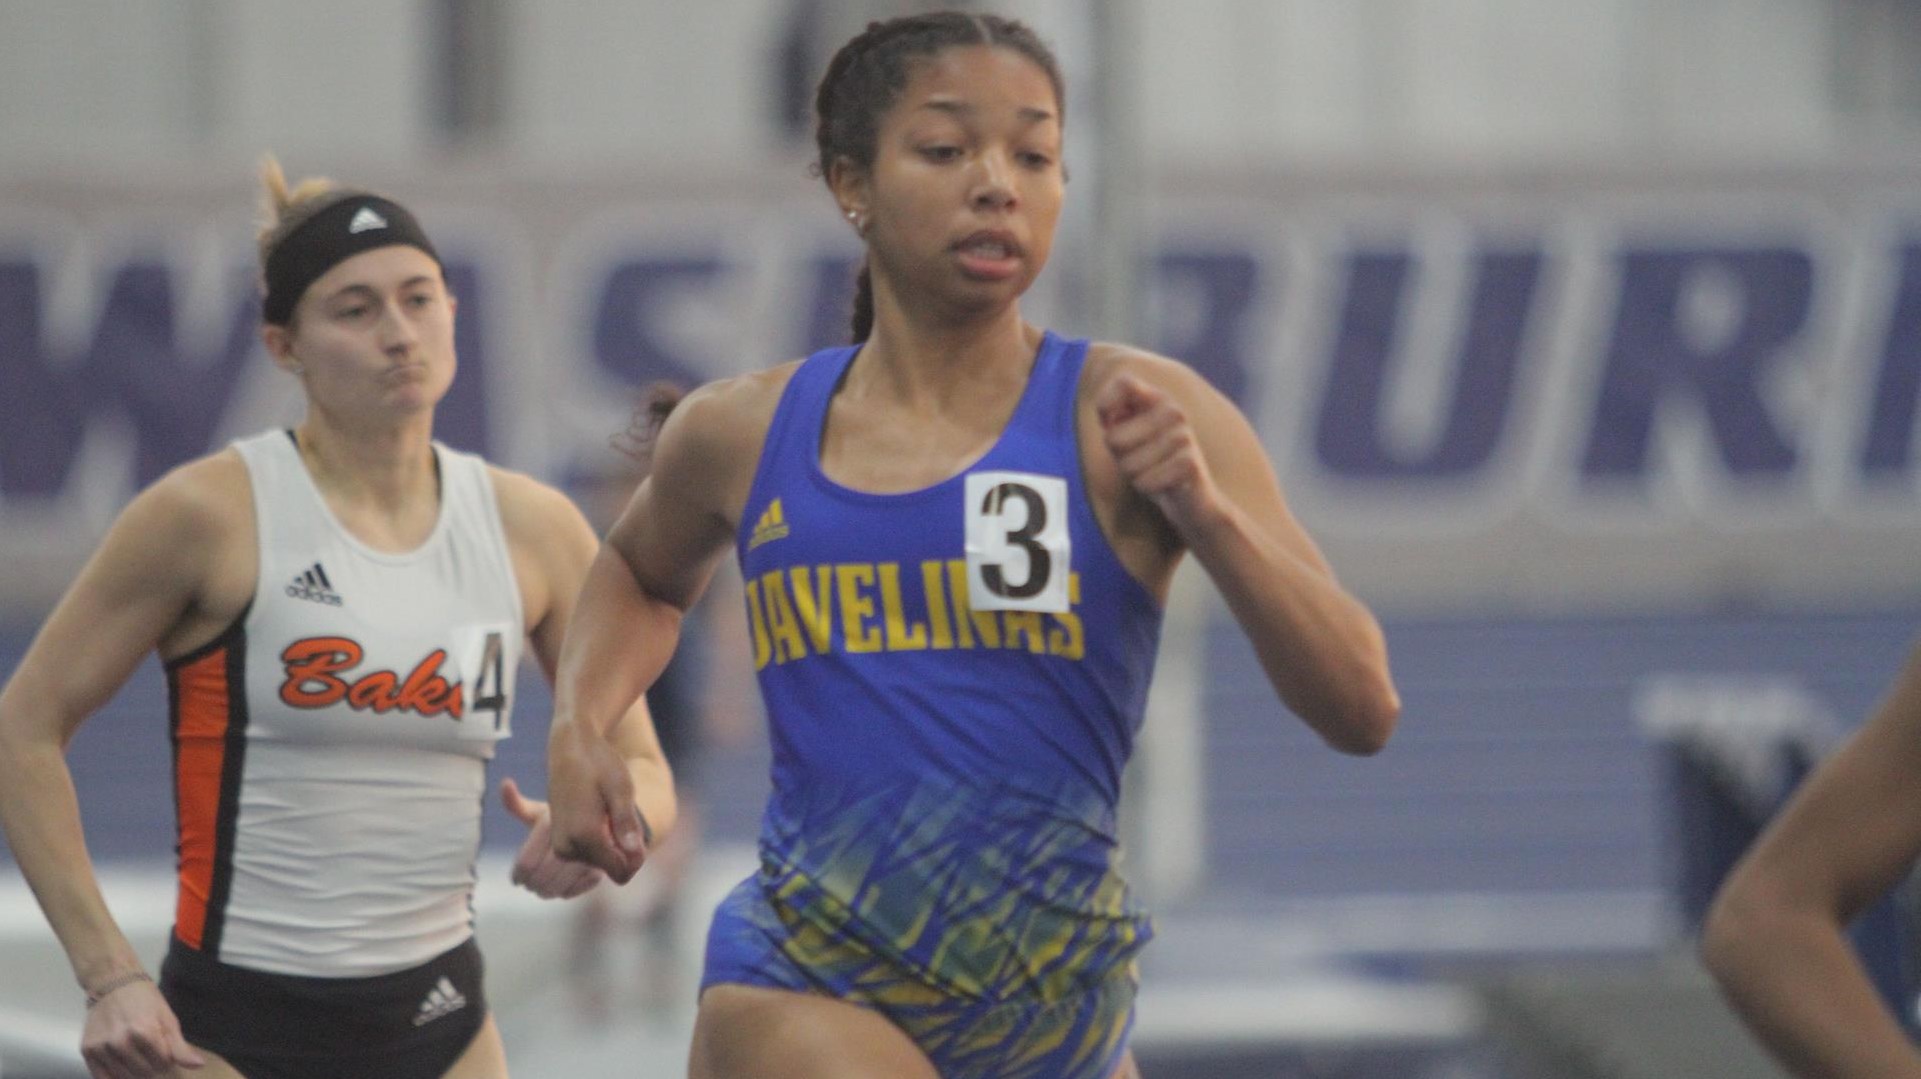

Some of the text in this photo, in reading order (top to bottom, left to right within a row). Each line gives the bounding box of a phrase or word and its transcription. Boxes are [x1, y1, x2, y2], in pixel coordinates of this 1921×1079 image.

[0, 243, 1921, 496] WSUR
[981, 482, 1051, 599] 3
[472, 632, 507, 731] 4
